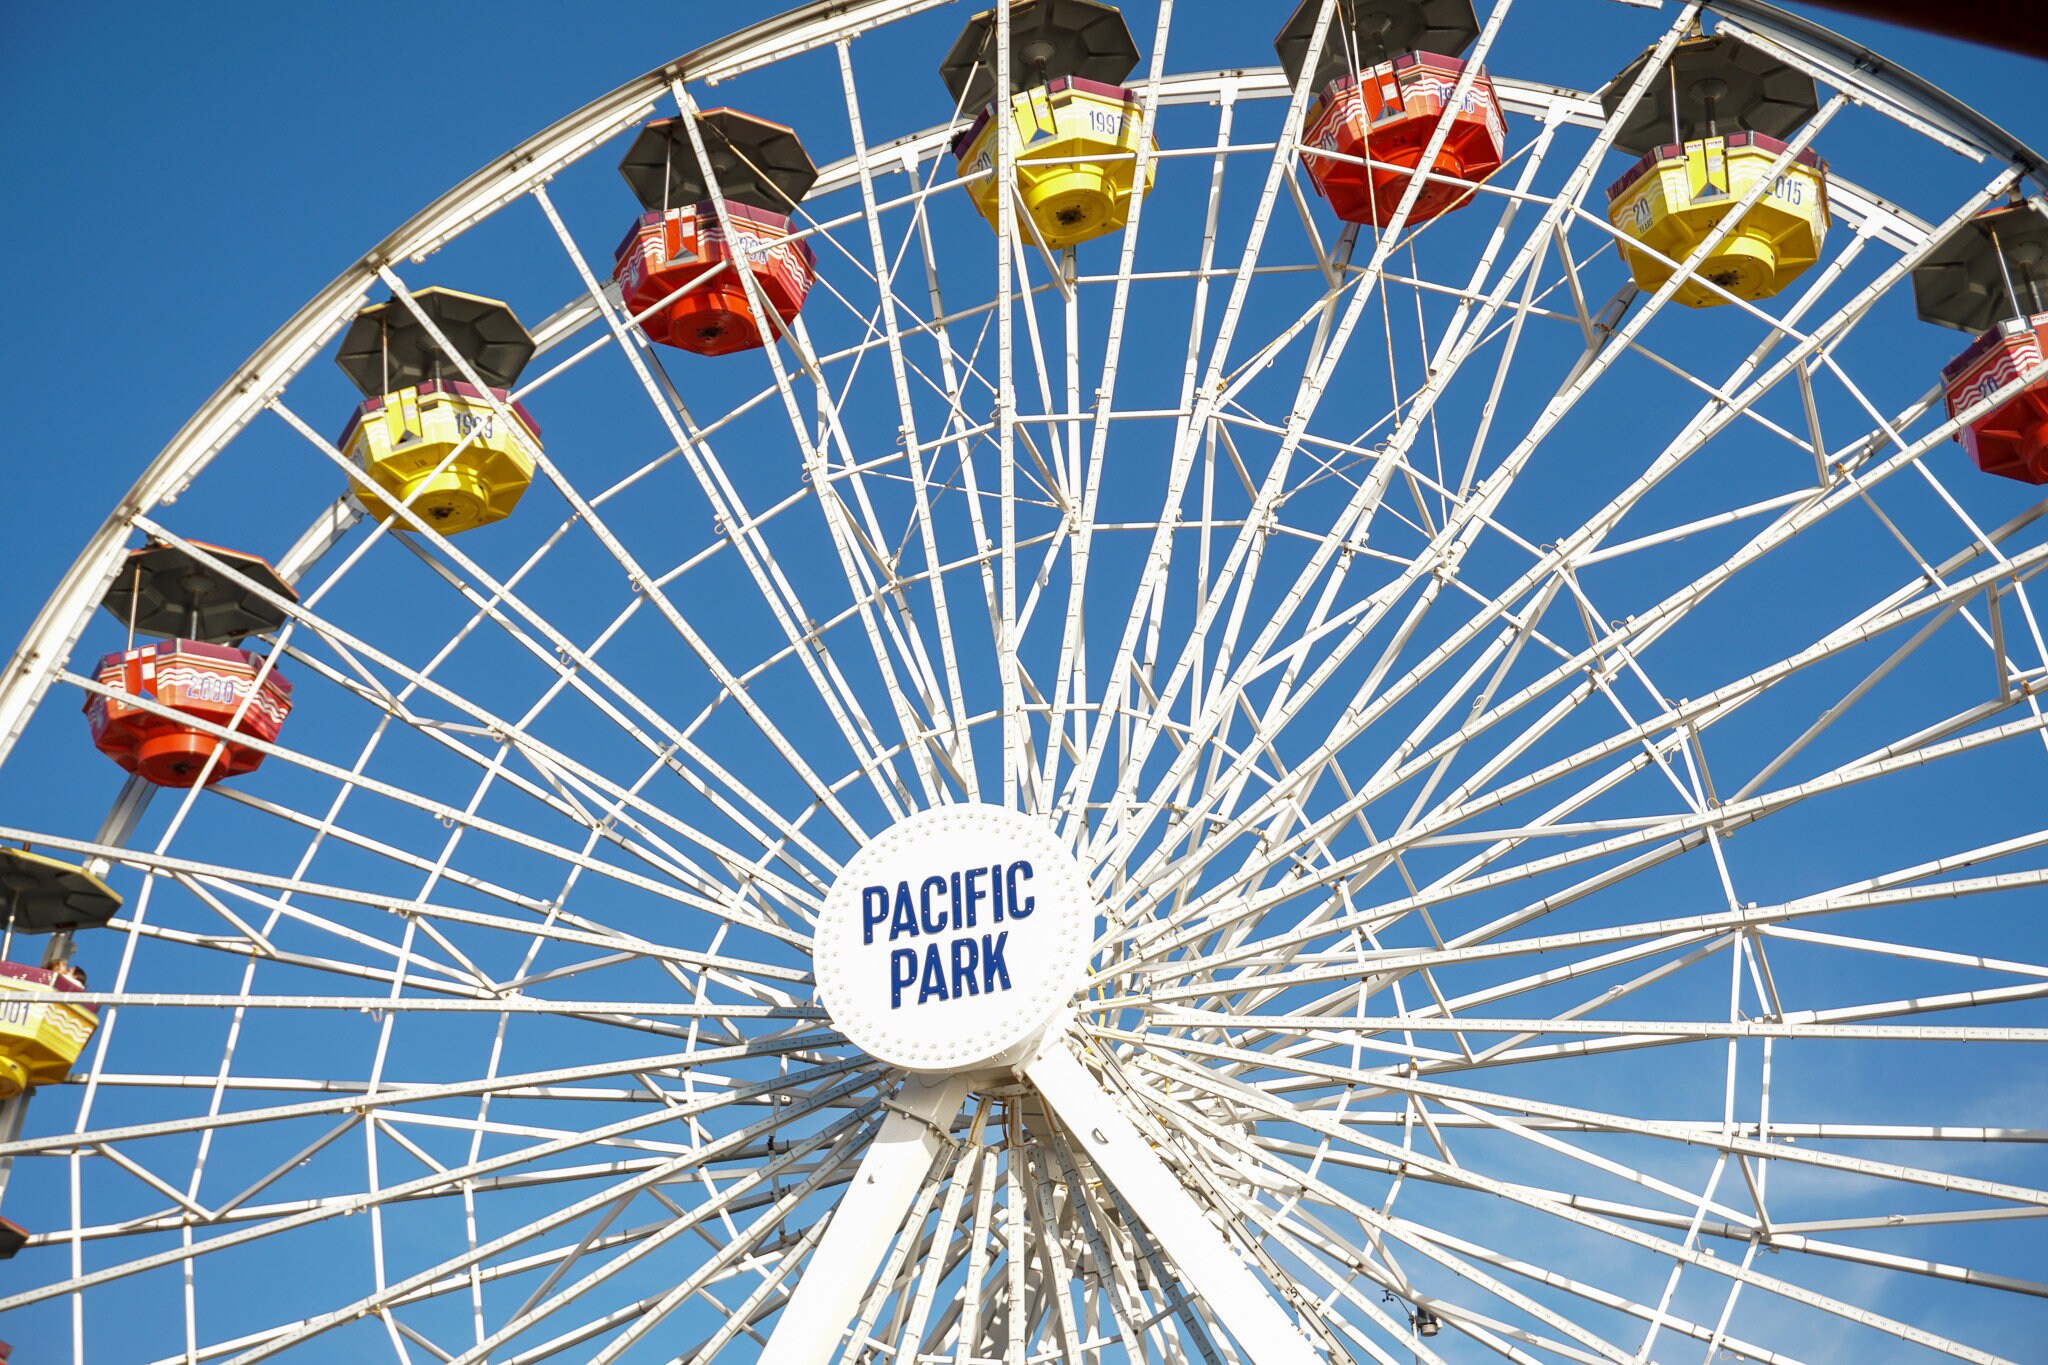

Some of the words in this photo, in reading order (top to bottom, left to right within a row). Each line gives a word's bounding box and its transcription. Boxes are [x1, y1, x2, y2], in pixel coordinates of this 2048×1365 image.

[1437, 84, 1474, 113] 196
[1089, 110, 1123, 137] 1997
[1764, 175, 1803, 205] 015
[1633, 197, 1652, 224] 20
[187, 675, 234, 704] 2000
[862, 860, 1035, 945] PACIFIC
[891, 931, 1012, 1009] PARK
